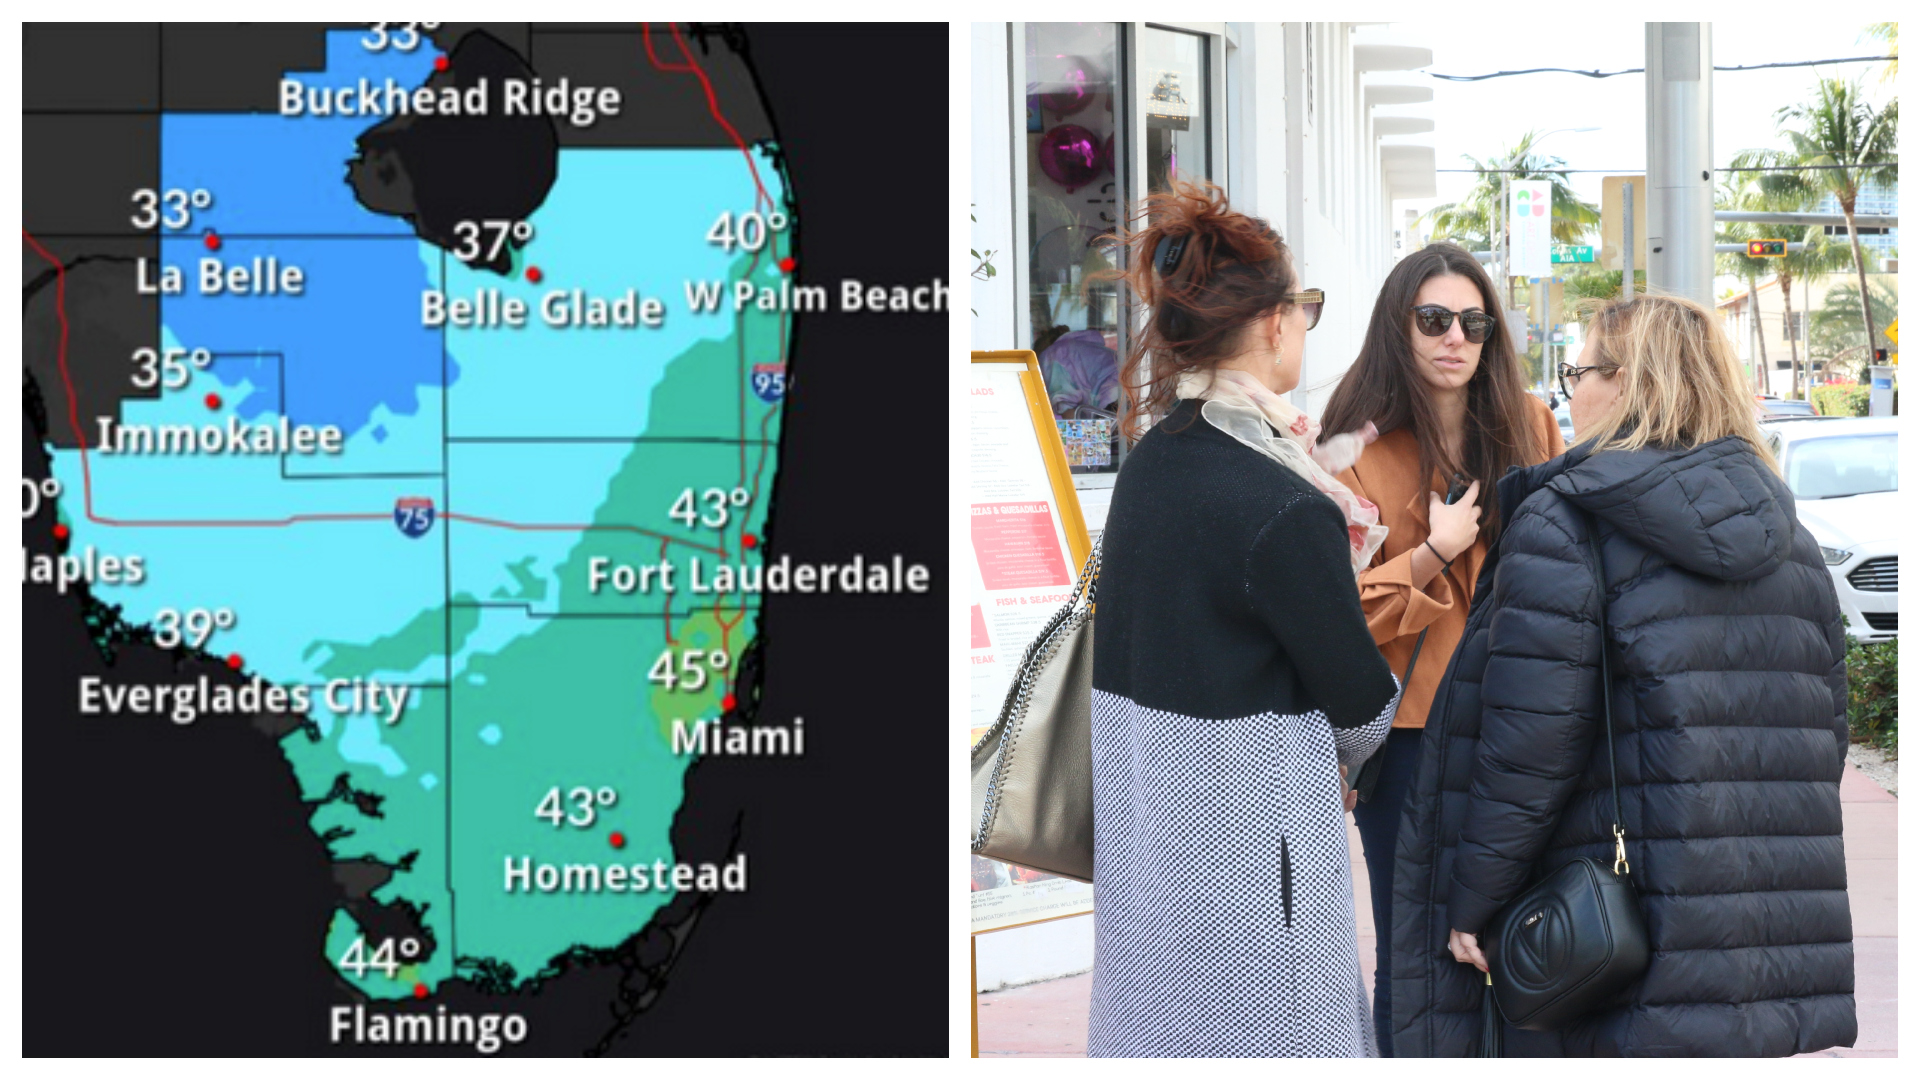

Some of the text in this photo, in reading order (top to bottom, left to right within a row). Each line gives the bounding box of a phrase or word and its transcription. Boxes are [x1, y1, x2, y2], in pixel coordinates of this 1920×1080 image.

[1148, 66, 1182, 91] ICE
[279, 78, 621, 126] Buckhead Ridge
[131, 189, 211, 229] 33°
[453, 221, 533, 261] 37°
[705, 211, 787, 251] 40°
[1576, 247, 1588, 255] Av
[137, 257, 304, 293] La Belle
[421, 289, 663, 326] Belle Glade
[683, 279, 949, 311] W Palm Beach
[131, 347, 211, 388] 35°
[755, 373, 786, 395] 95
[97, 415, 342, 454] Immokalee
[399, 508, 429, 530] 75
[668, 487, 749, 528] 43°
[993, 506, 1000, 515] &
[1000, 504, 1048, 514] QUESADILLAS
[589, 556, 930, 593] Fort Lauderdale
[995, 598, 1018, 606] FISH
[1020, 597, 1028, 605] &
[154, 608, 234, 649] 39°
[647, 649, 728, 690] 45°
[80, 676, 410, 724] Everglades City
[671, 718, 803, 755] Miami
[534, 787, 616, 827] 43°
[504, 854, 746, 891] Homestead
[338, 938, 420, 978] 44°
[331, 1005, 527, 1054] Flamingo
